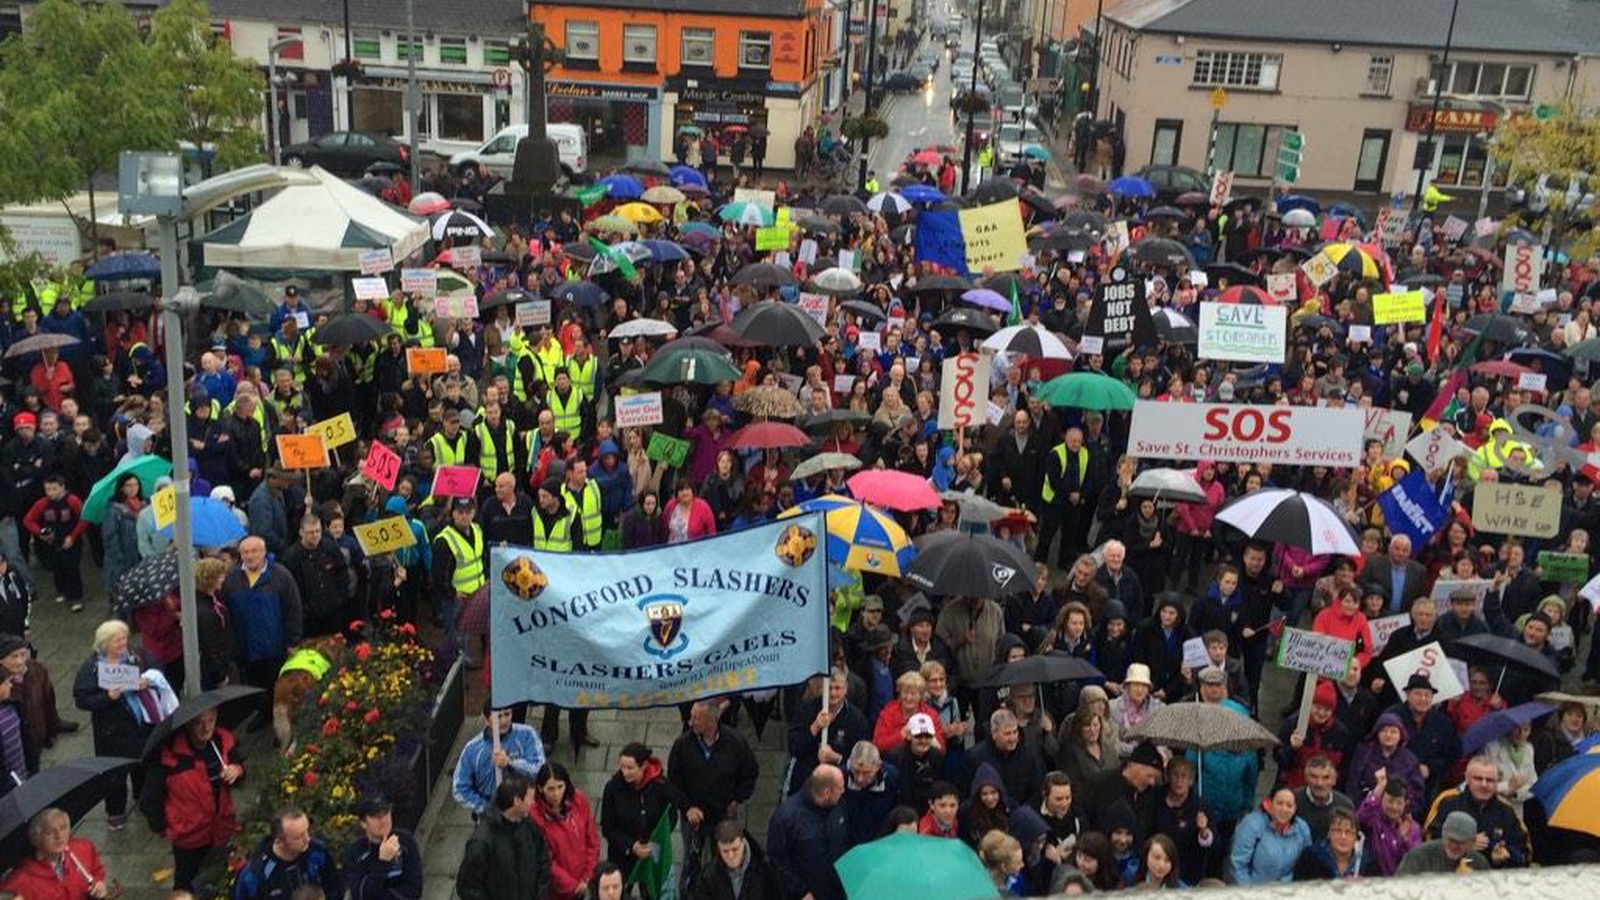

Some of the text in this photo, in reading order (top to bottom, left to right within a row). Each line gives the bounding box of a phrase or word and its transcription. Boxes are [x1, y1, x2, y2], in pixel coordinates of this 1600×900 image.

[447, 226, 479, 237] PING
[1103, 283, 1135, 302] JOBS
[1107, 300, 1133, 317] NOT
[1216, 304, 1264, 325] SAVE
[1104, 315, 1136, 334] DEBT
[954, 352, 979, 428] SOS
[618, 405, 639, 417] Save
[1203, 407, 1292, 443] S.O.S
[1136, 441, 1170, 454] Save
[1199, 443, 1290, 459] Christophers
[1294, 448, 1353, 461] Services
[1485, 512, 1528, 530] WAKE
[512, 567, 811, 636] LONGFORD SLASHERS
[530, 653, 693, 681] SLASHERS
[704, 630, 797, 663] GAELS
